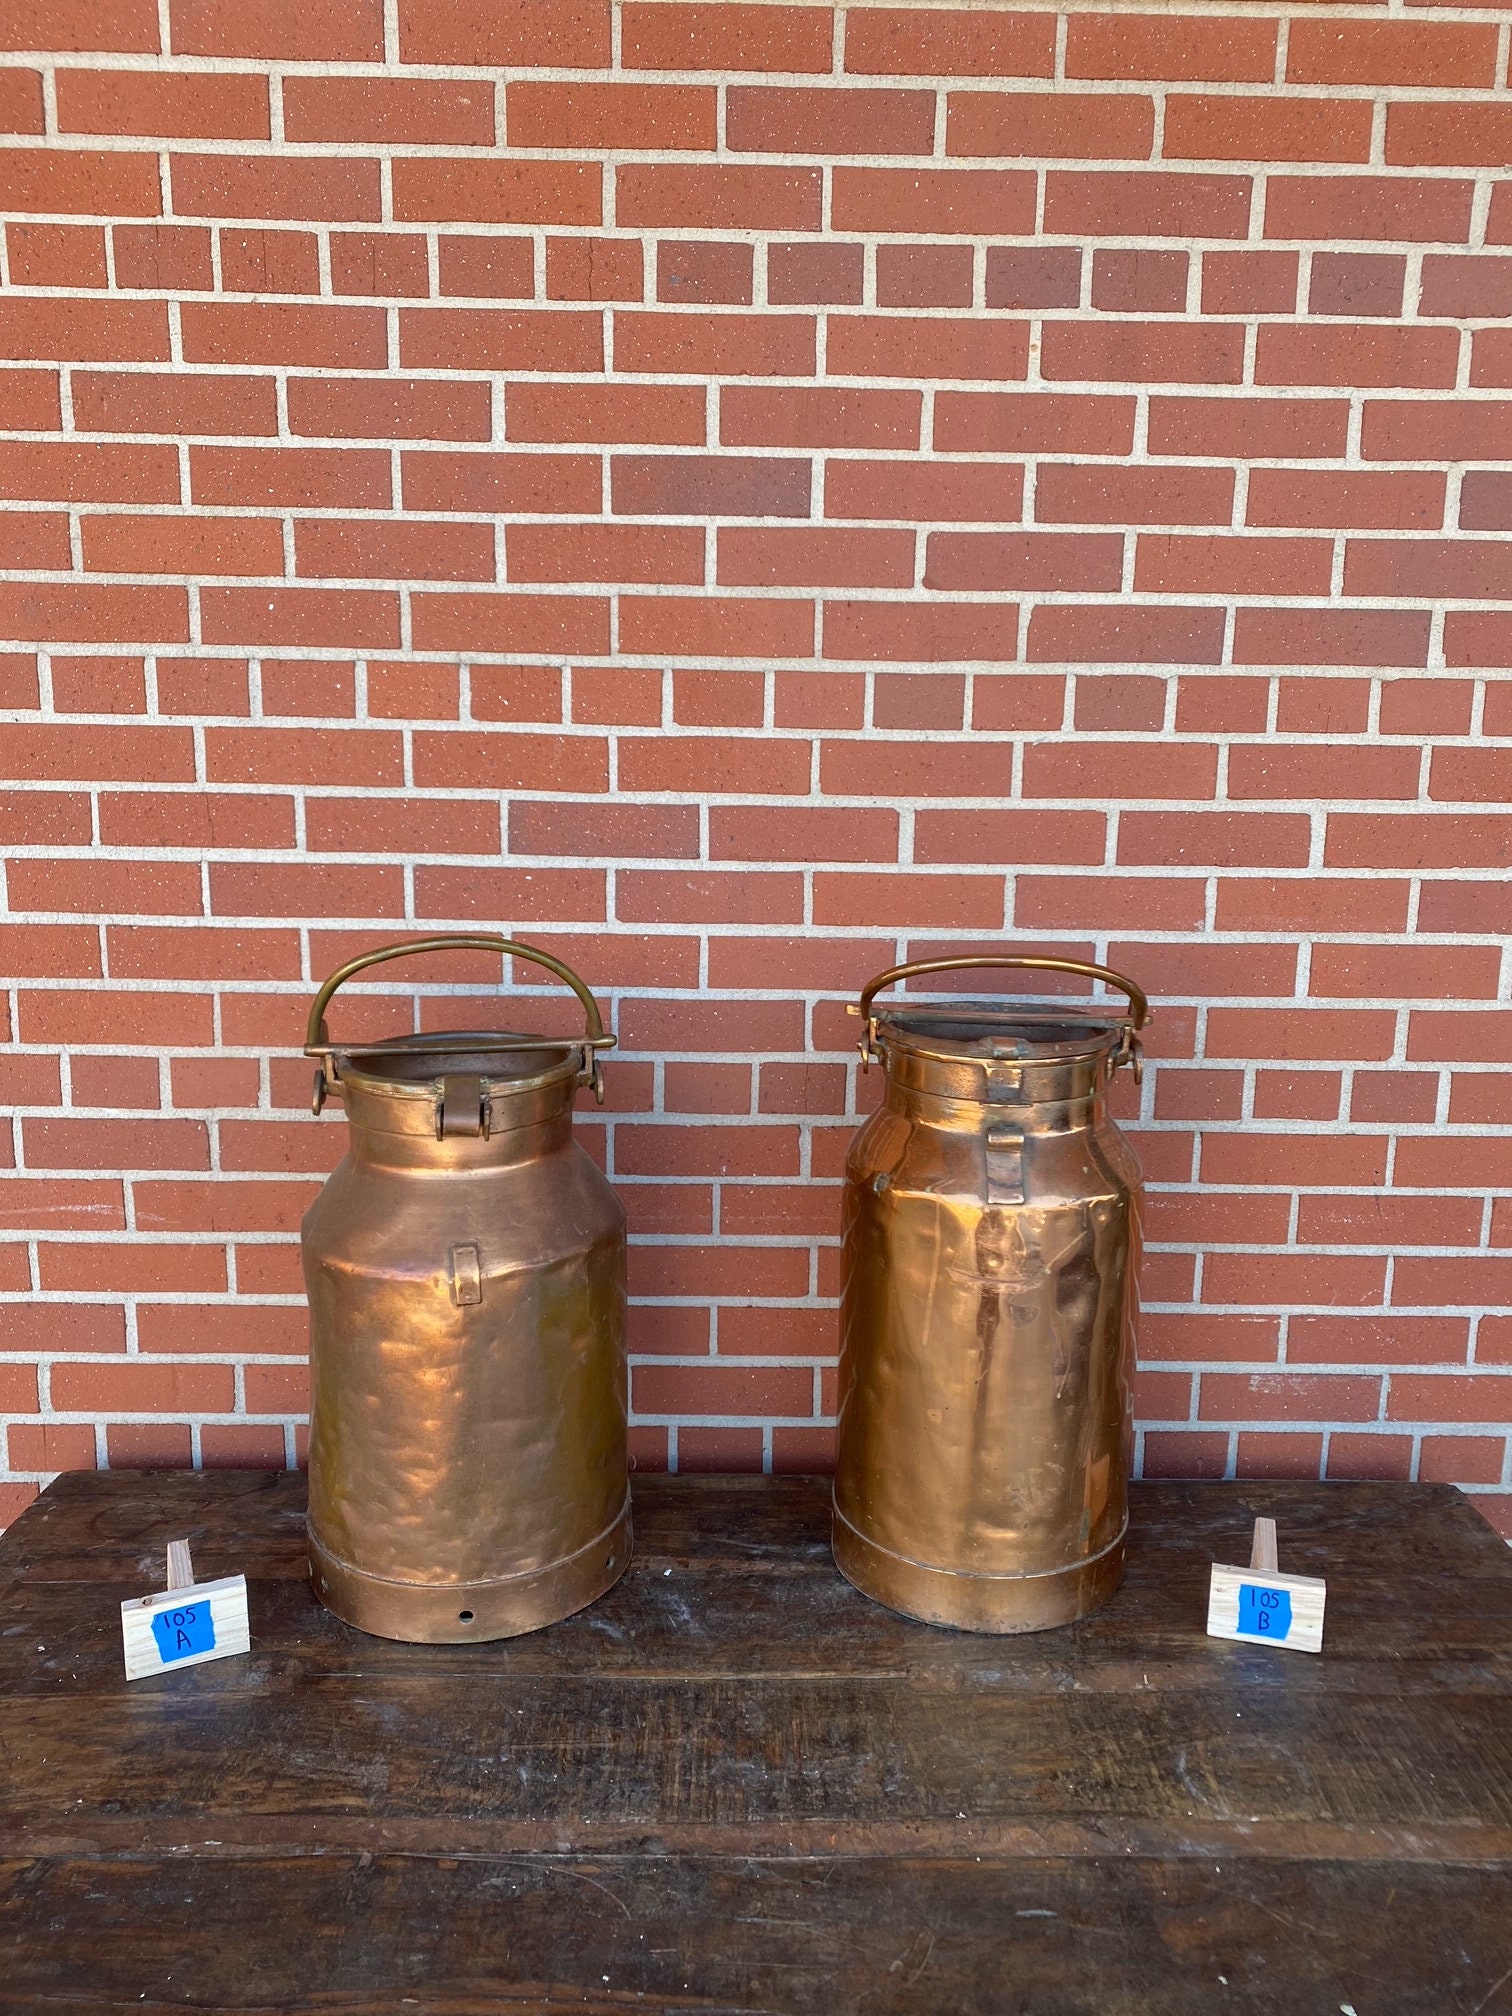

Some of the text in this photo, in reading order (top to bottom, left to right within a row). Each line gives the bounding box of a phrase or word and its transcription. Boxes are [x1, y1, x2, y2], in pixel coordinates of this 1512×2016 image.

[1251, 1588, 1280, 1609] 105
[164, 1607, 196, 1629] 105
[1258, 1610, 1270, 1631] B
[177, 1629, 191, 1650] A
